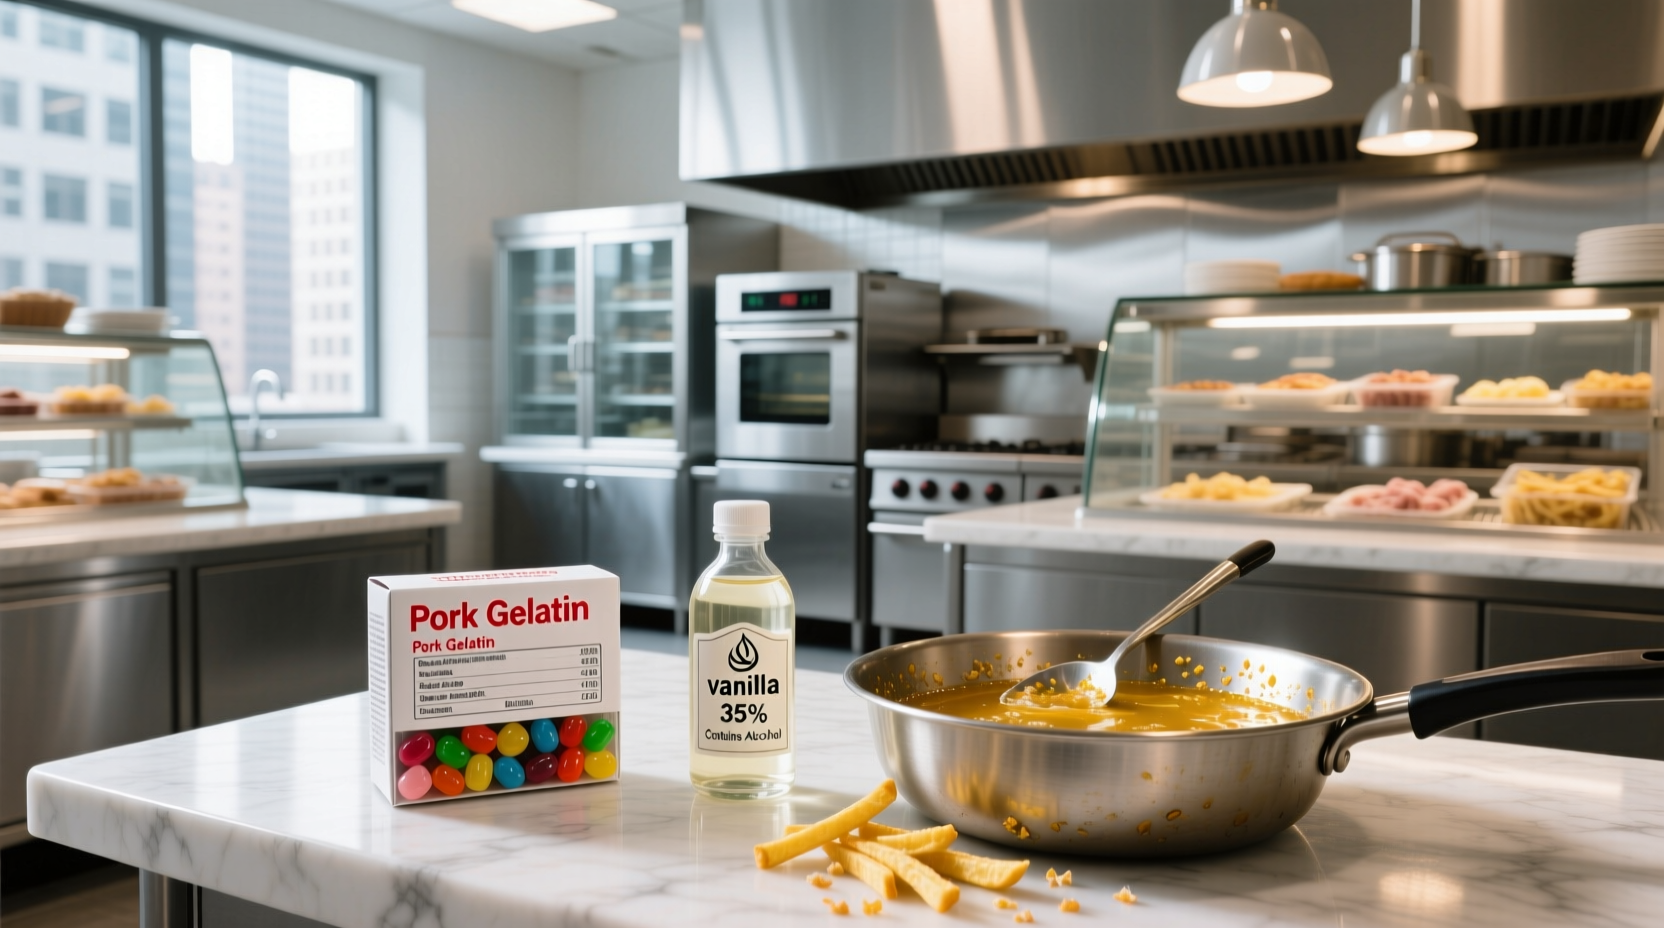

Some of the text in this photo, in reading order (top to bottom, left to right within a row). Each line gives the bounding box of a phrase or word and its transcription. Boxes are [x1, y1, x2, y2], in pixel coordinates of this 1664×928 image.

[409, 595, 590, 632] Pork Gelatin
[412, 636, 495, 653] Pork Gelatin
[707, 674, 780, 696] vanilla
[720, 703, 768, 724] 35%
